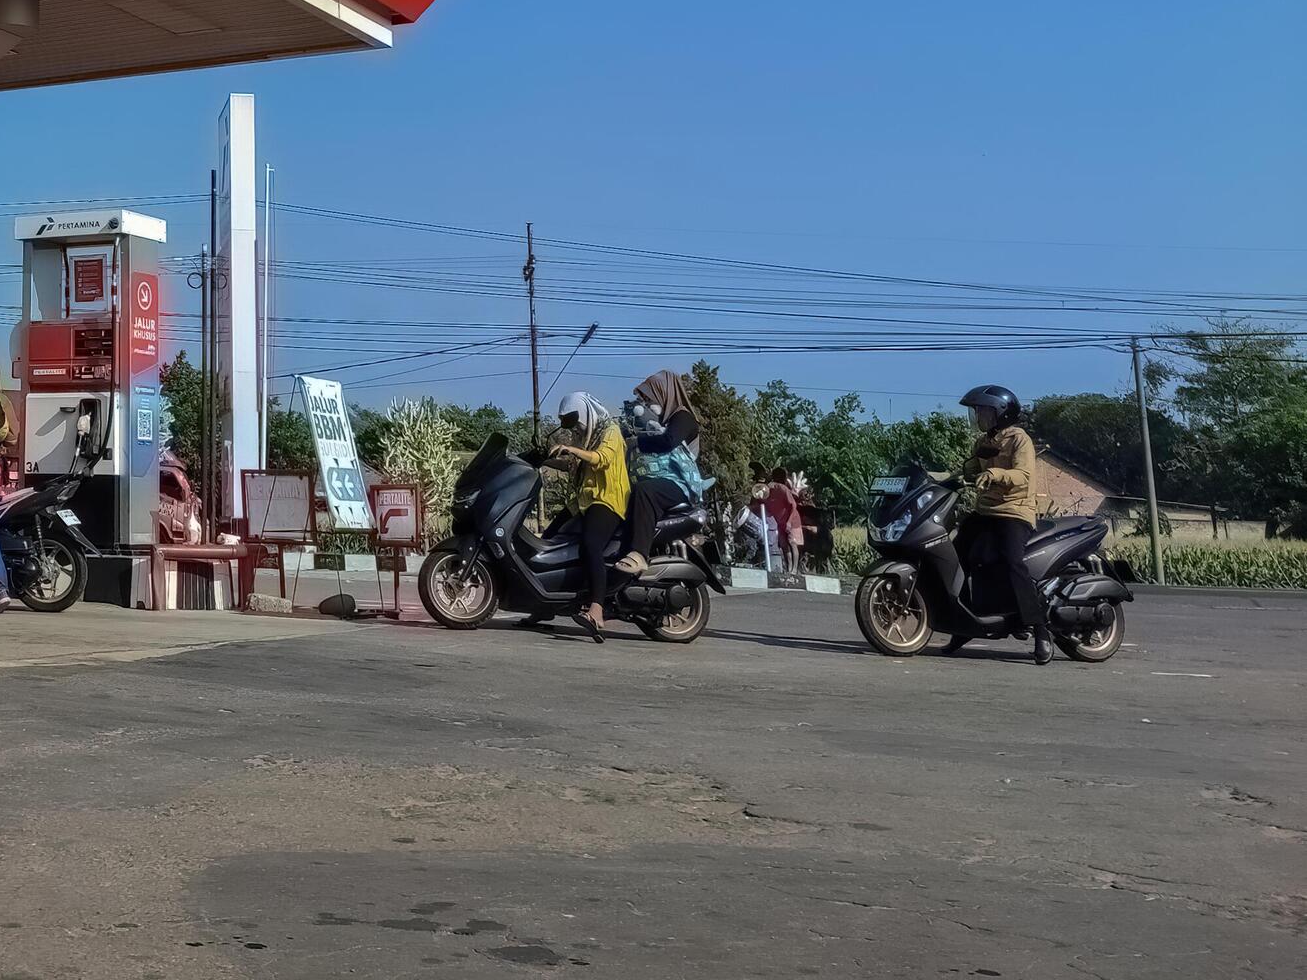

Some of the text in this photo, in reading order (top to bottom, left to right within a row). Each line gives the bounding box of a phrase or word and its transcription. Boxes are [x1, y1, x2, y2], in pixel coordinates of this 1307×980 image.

[57, 220, 101, 230] PERTAMINA
[133, 316, 156, 330] JALUR
[133, 329, 156, 341] KHUSUS
[313, 413, 347, 442] BBM
[26, 461, 39, 473] 3A
[379, 491, 412, 505] PERTALITE
